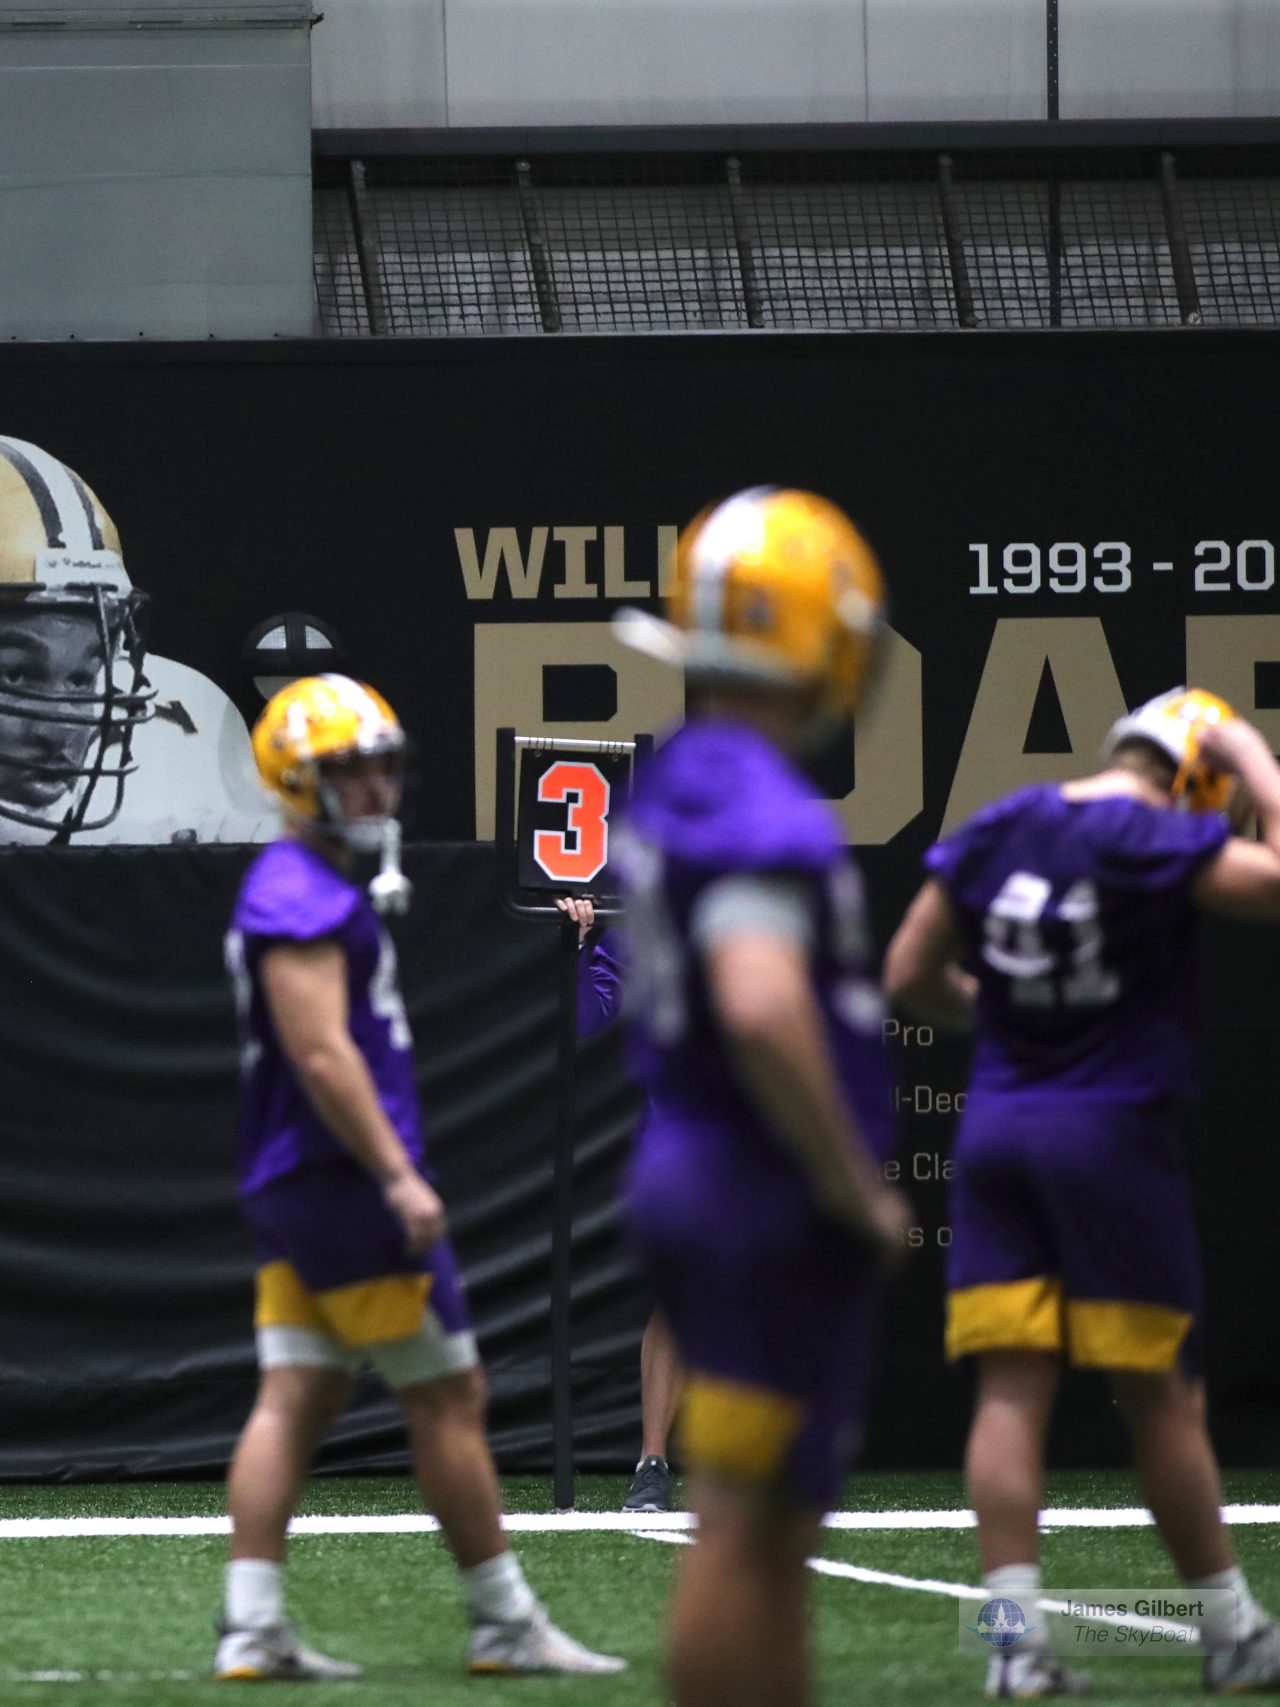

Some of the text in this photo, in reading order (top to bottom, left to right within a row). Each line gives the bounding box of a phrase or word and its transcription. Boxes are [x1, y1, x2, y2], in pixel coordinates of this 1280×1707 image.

[969, 542, 1132, 594] 1993
[1194, 539, 1275, 592] 20
[533, 760, 611, 883] 3
[882, 1018, 934, 1046] Pro
